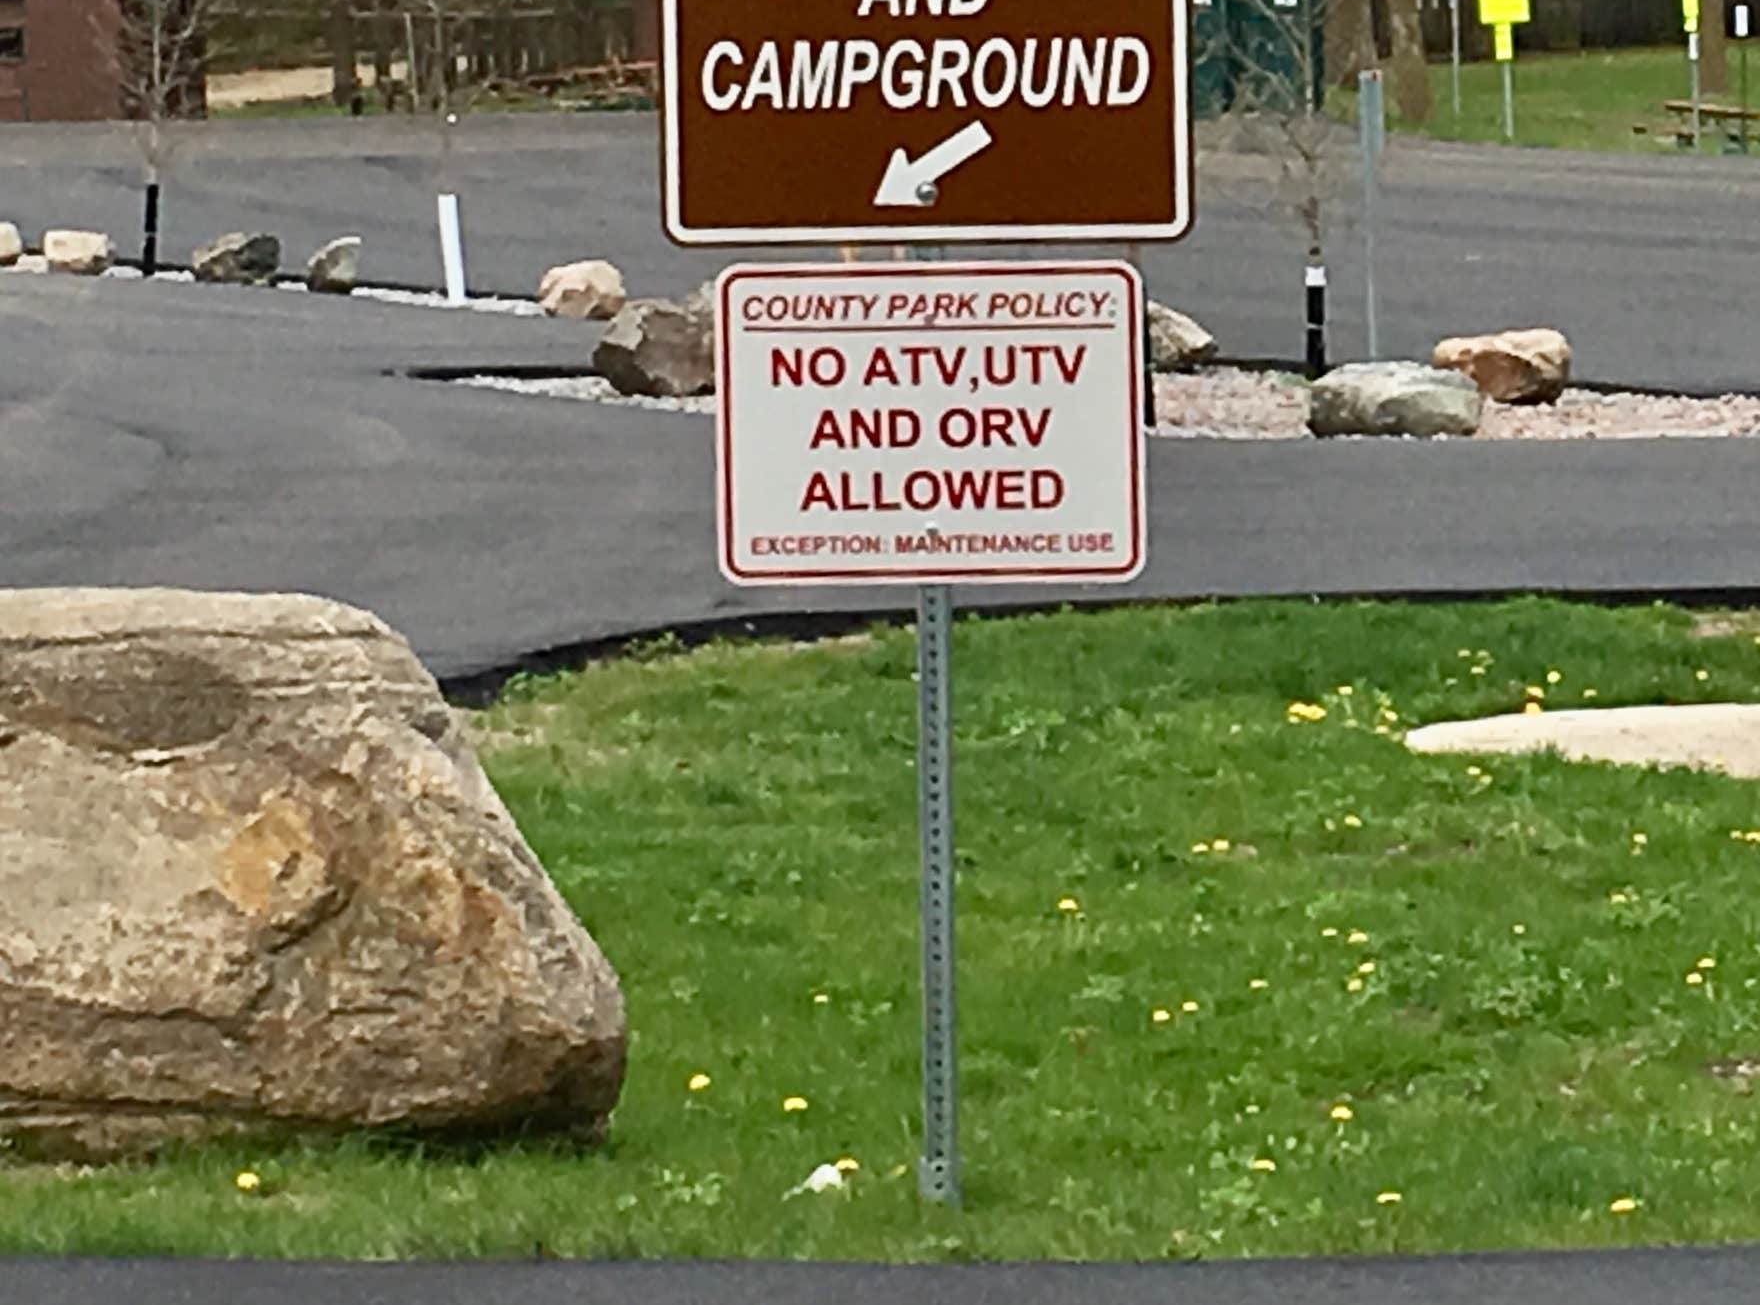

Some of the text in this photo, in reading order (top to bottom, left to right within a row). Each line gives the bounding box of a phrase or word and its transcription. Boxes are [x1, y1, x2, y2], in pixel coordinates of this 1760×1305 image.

[701, 36, 1150, 111] CAMPGROUND
[742, 291, 1117, 321] COUNTY PARK POLICY:
[770, 347, 846, 386] NO
[809, 407, 1051, 449] AND ORV
[801, 469, 1065, 511] ALLOWED
[750, 532, 1114, 556] EXCEPTION: MAINTENANCE USE
